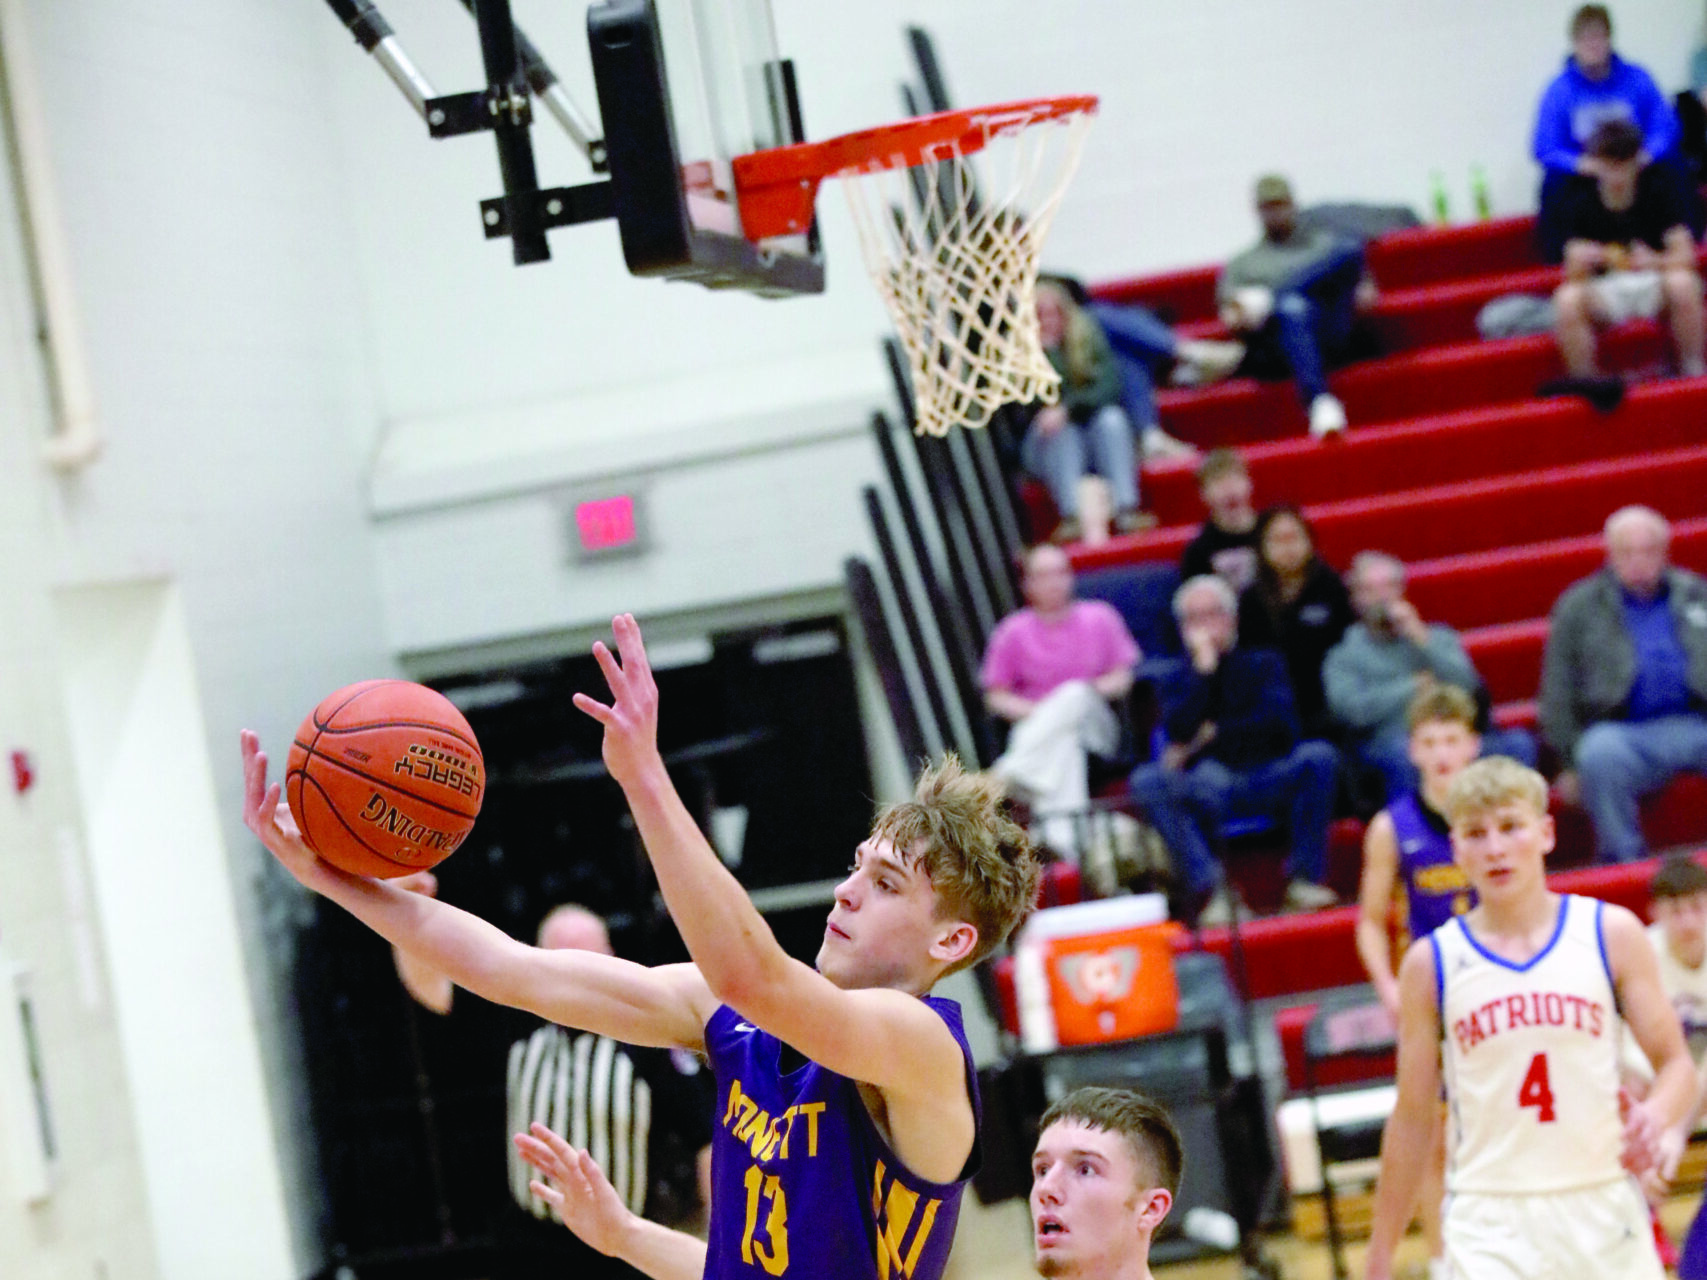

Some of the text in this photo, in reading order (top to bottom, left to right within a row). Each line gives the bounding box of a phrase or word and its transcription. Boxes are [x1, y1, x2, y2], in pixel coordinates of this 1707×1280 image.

[393, 756, 481, 803] LEGACY
[1454, 993, 1604, 1056] PATRIOTS
[1518, 1052, 1556, 1123] 4
[741, 1164, 790, 1278] 13
